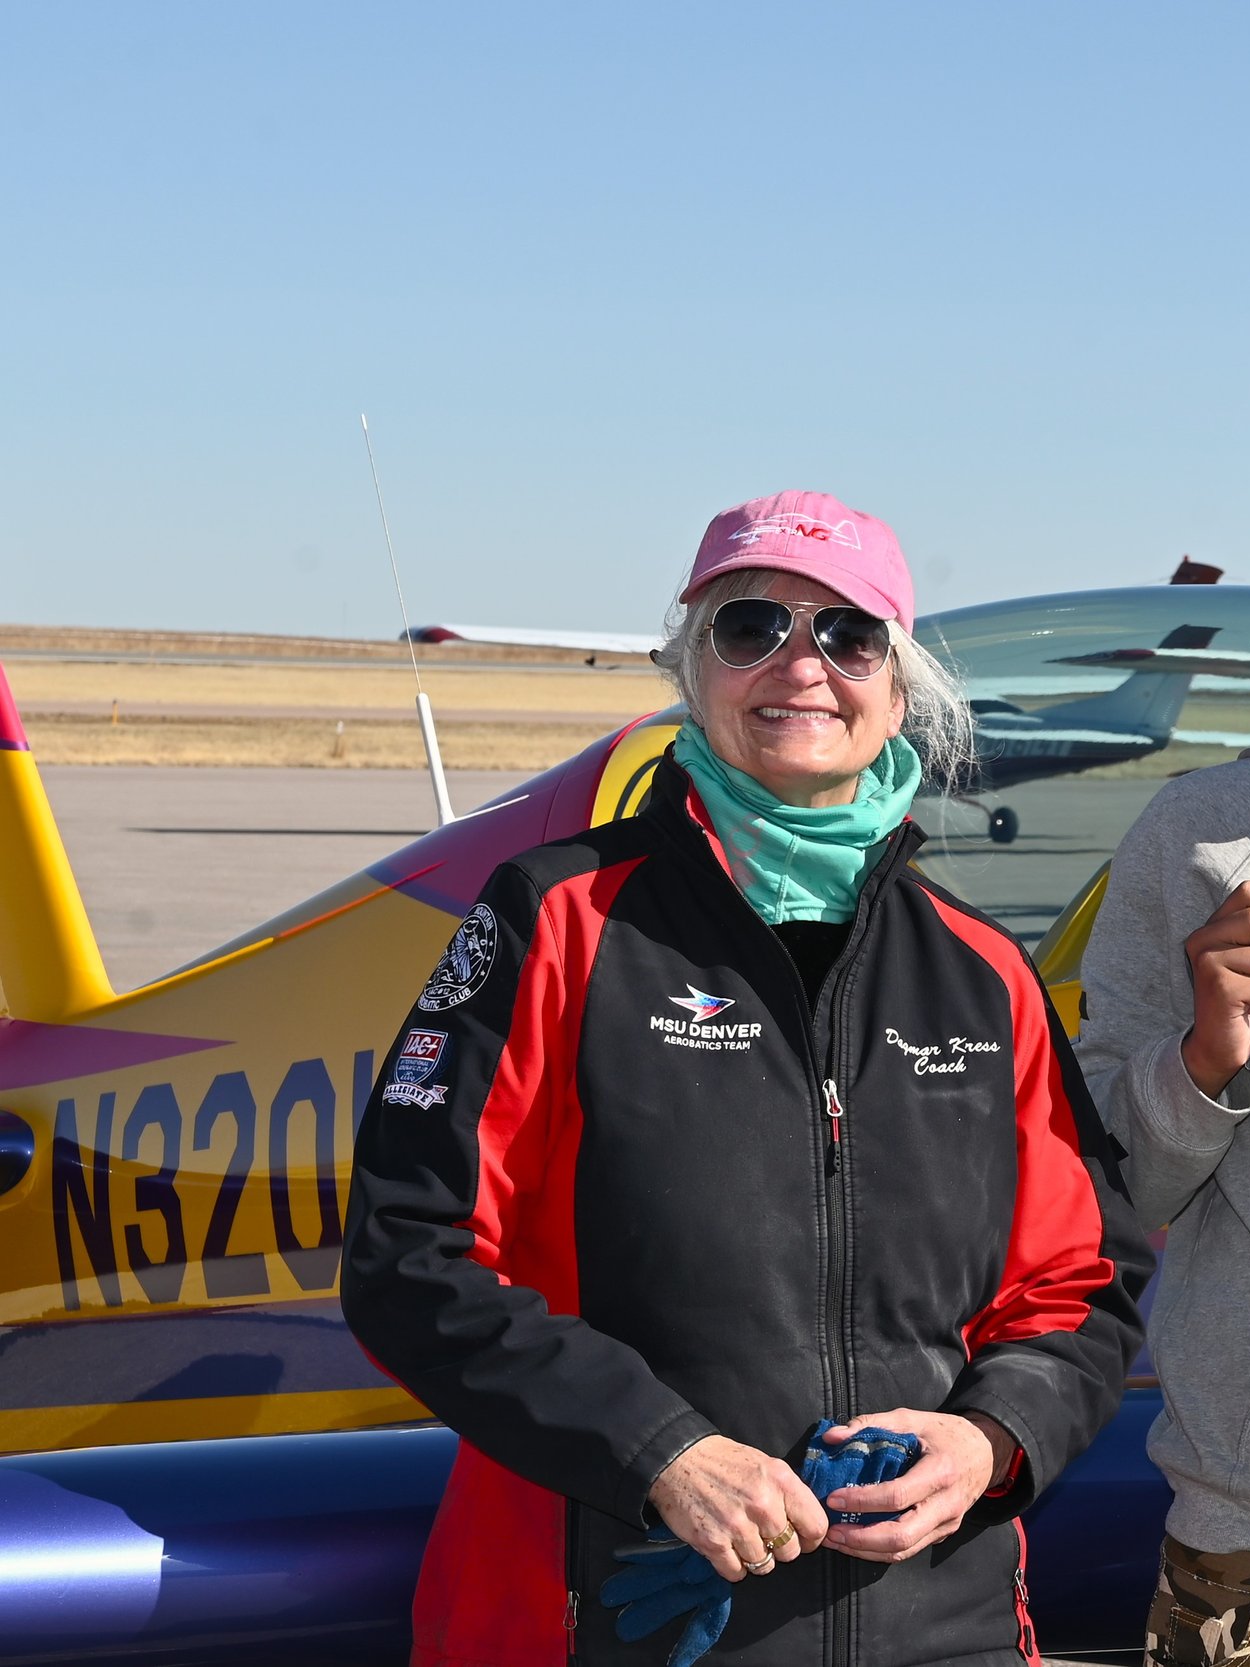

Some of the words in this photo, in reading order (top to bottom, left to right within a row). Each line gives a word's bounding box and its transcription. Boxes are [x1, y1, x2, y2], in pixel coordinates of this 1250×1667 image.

[448, 987, 472, 1005] CLUB
[650, 1016, 687, 1035] MSU
[689, 1023, 762, 1039] DENVER
[403, 1035, 432, 1056] IAC
[664, 1035, 722, 1051] AEROBATICS
[723, 1041, 751, 1050] TEAM
[885, 1028, 942, 1056] Dagmar
[948, 1036, 1001, 1054] Kress
[914, 1055, 967, 1076] Coach
